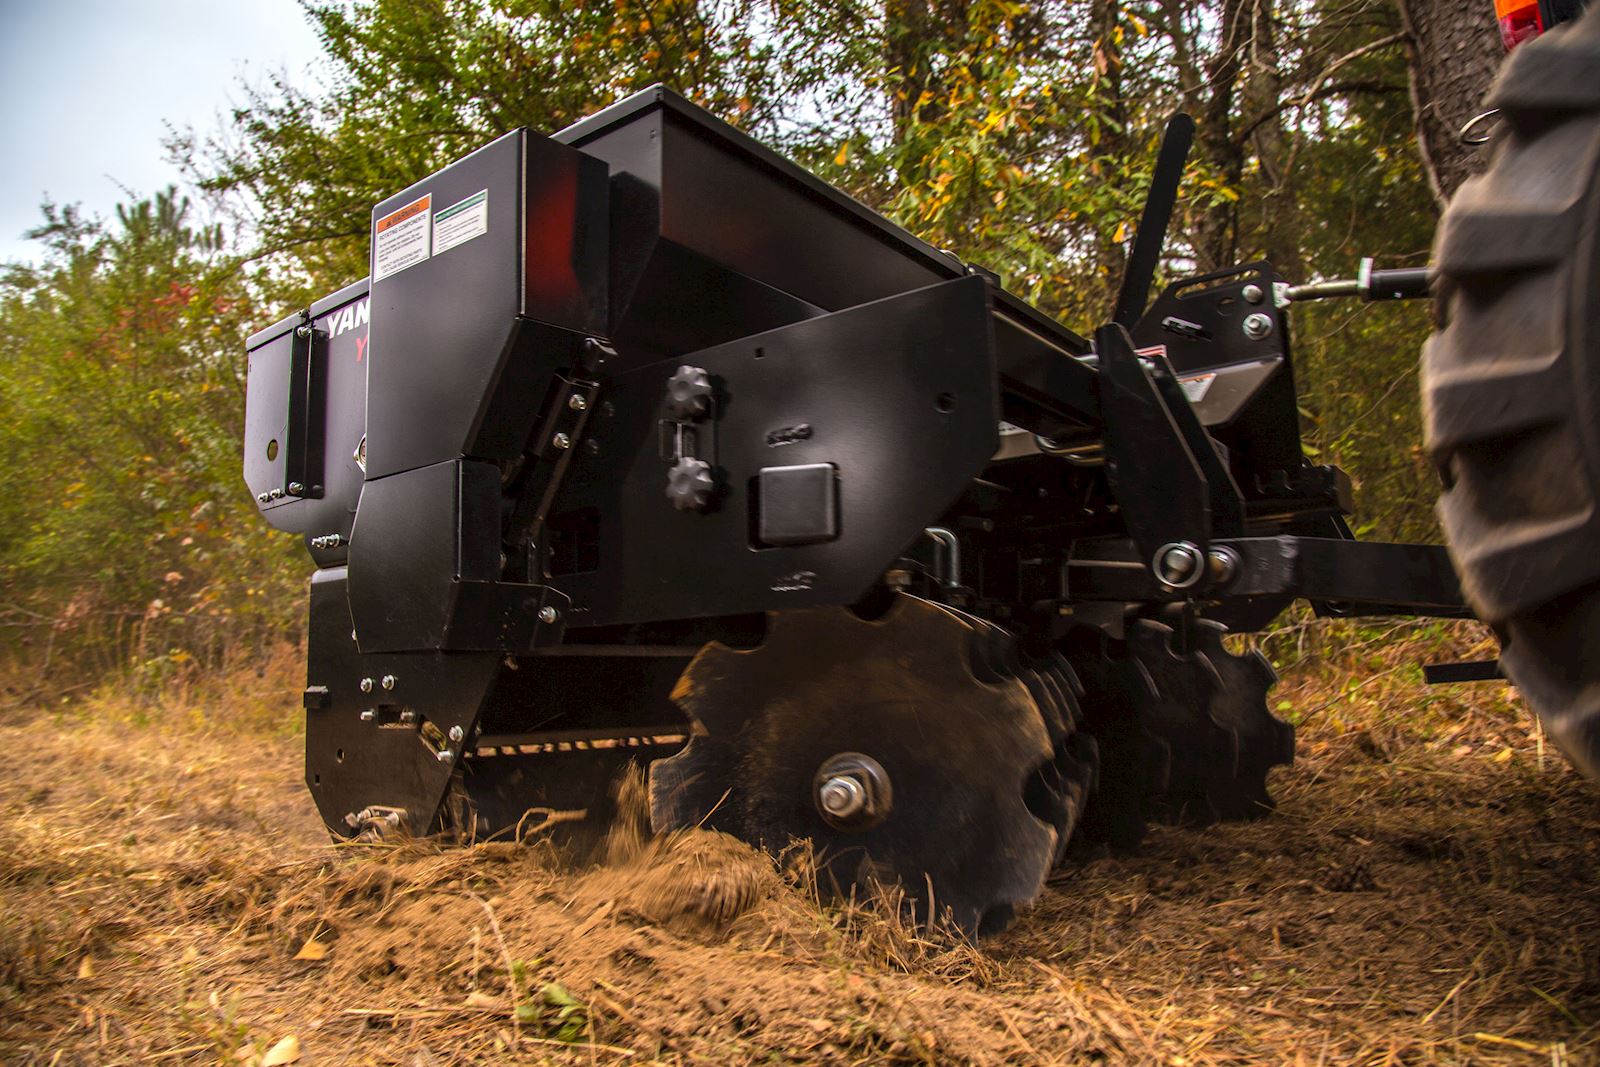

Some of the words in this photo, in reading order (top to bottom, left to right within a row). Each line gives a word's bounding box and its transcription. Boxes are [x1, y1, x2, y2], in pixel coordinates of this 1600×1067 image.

[392, 203, 420, 221] WARNING
[380, 227, 398, 240] ROTATING
[398, 213, 427, 232] COMPONENTS
